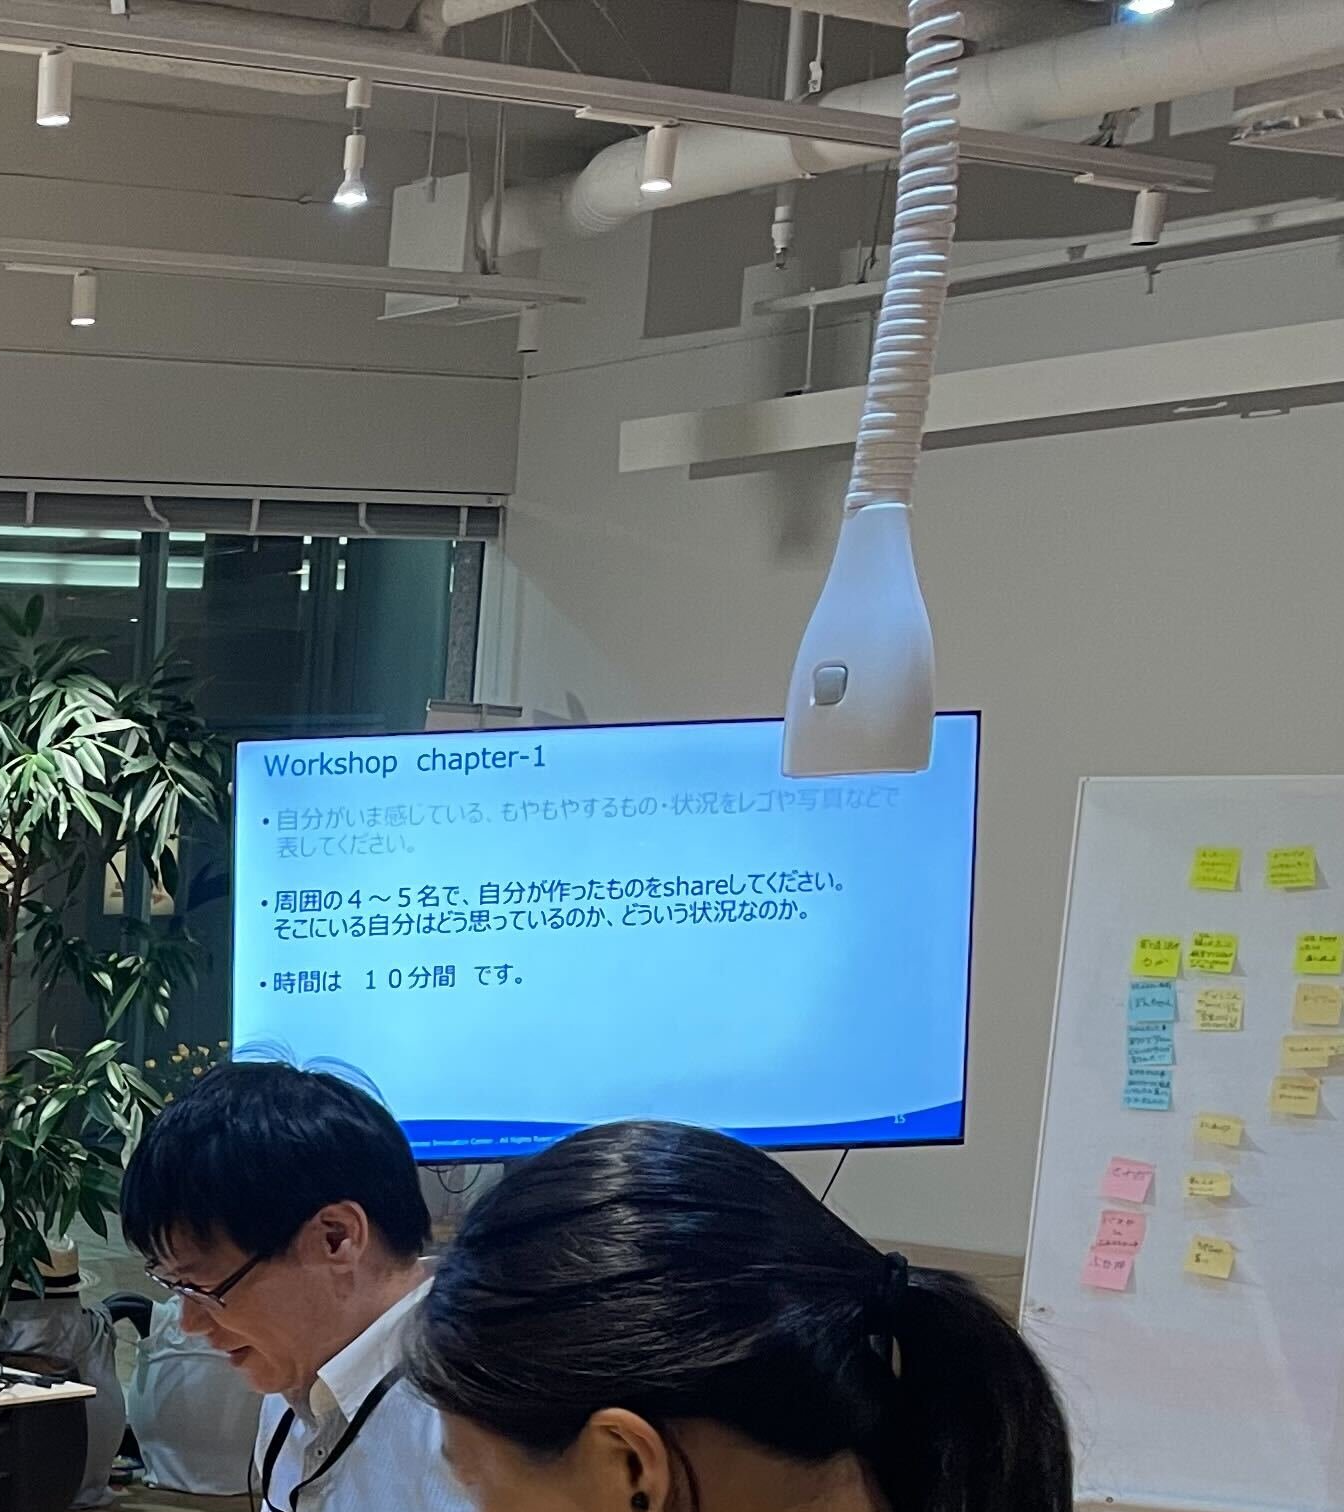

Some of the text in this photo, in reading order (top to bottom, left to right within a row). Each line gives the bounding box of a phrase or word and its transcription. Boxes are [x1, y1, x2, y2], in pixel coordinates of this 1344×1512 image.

[264, 745, 546, 778] Workshop chapter-1
[277, 833, 416, 859] 表してください。
[273, 899, 808, 940] そこにいる自分はどう思っているのか、どういう状況なのか。
[273, 969, 342, 994] 時間は
[473, 963, 523, 987] です。
